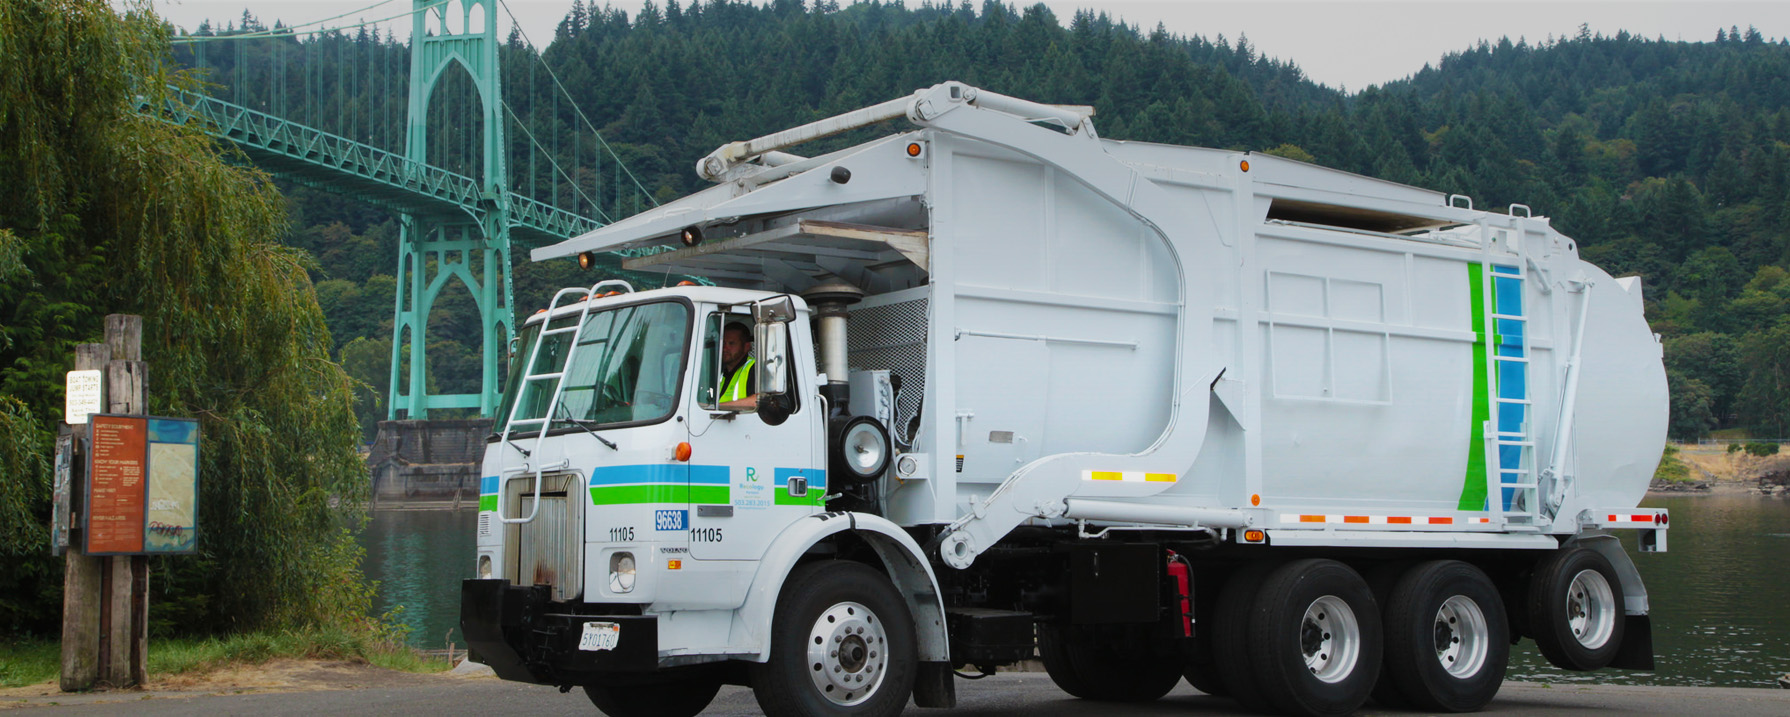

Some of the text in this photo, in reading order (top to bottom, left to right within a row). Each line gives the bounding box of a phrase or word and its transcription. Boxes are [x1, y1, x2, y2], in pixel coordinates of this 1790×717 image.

[656, 511, 682, 529] 96638
[610, 527, 634, 542] 11105
[691, 528, 722, 542] 11105
